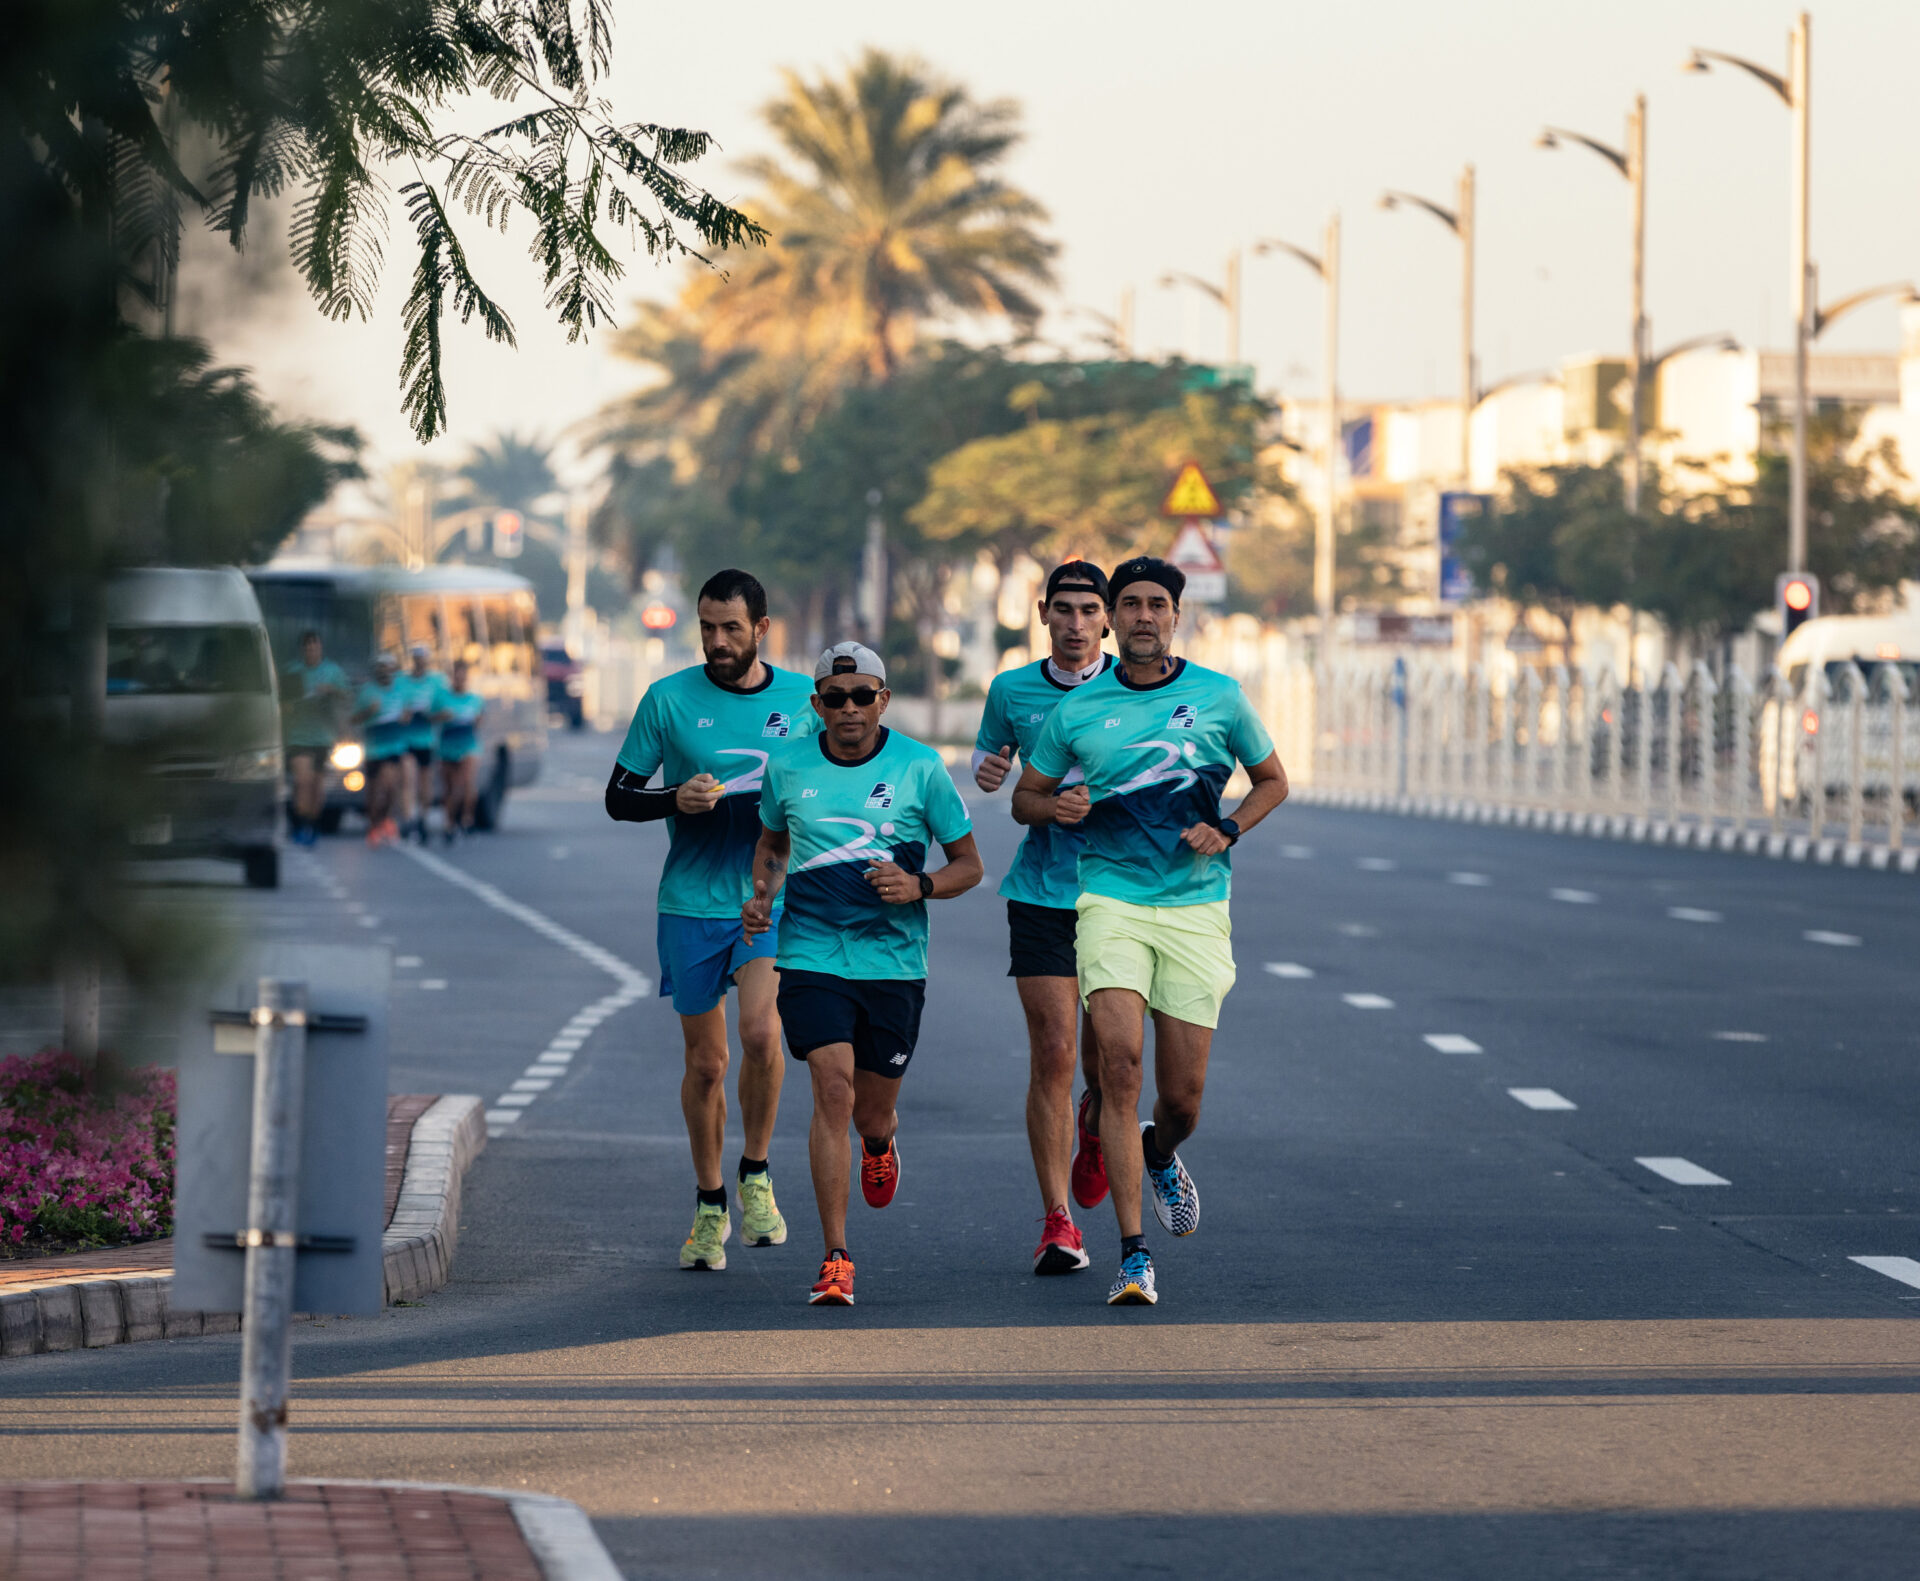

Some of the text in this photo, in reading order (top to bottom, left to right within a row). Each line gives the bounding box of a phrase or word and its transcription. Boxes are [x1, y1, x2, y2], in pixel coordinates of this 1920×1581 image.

[1184, 718, 1193, 728] 2
[779, 727, 788, 736] 2
[882, 798, 891, 807] 2
